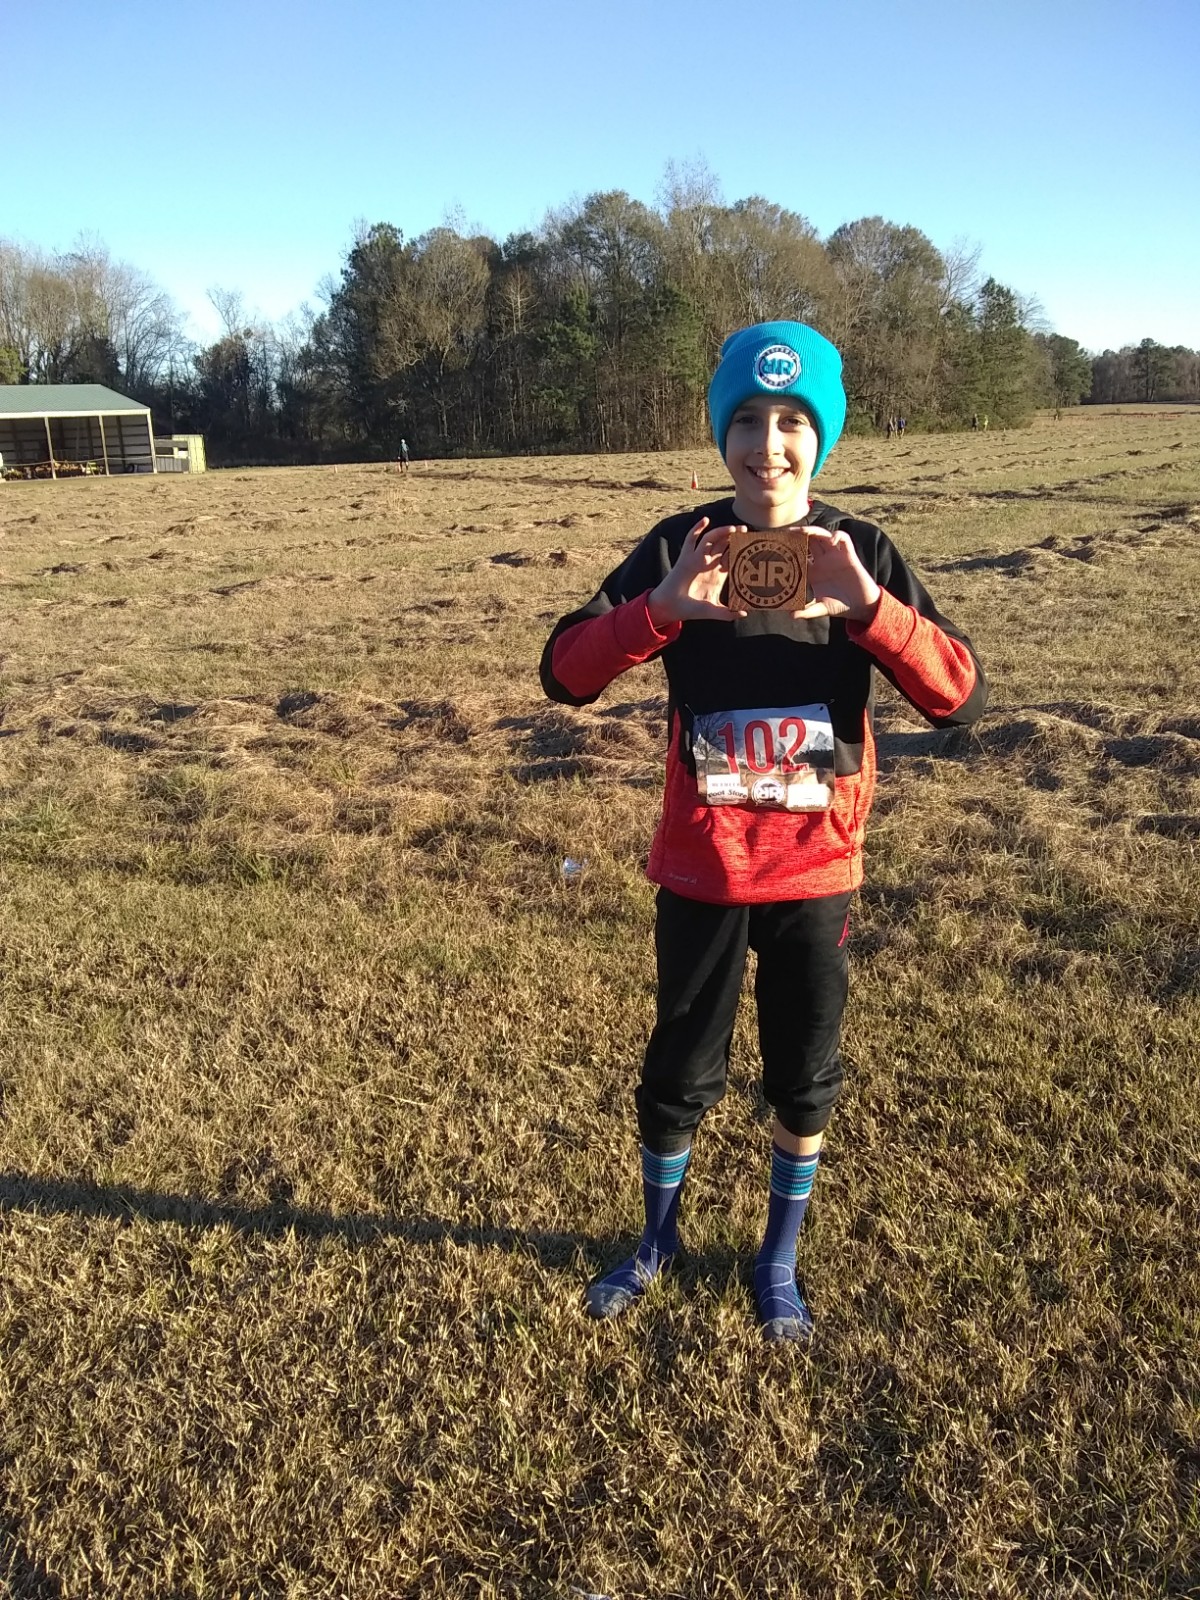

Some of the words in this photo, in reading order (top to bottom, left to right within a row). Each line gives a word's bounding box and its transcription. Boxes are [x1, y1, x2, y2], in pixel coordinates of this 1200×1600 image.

[742, 590, 789, 604] RETREAT
[717, 717, 809, 775] 102
[728, 789, 748, 799] Store
